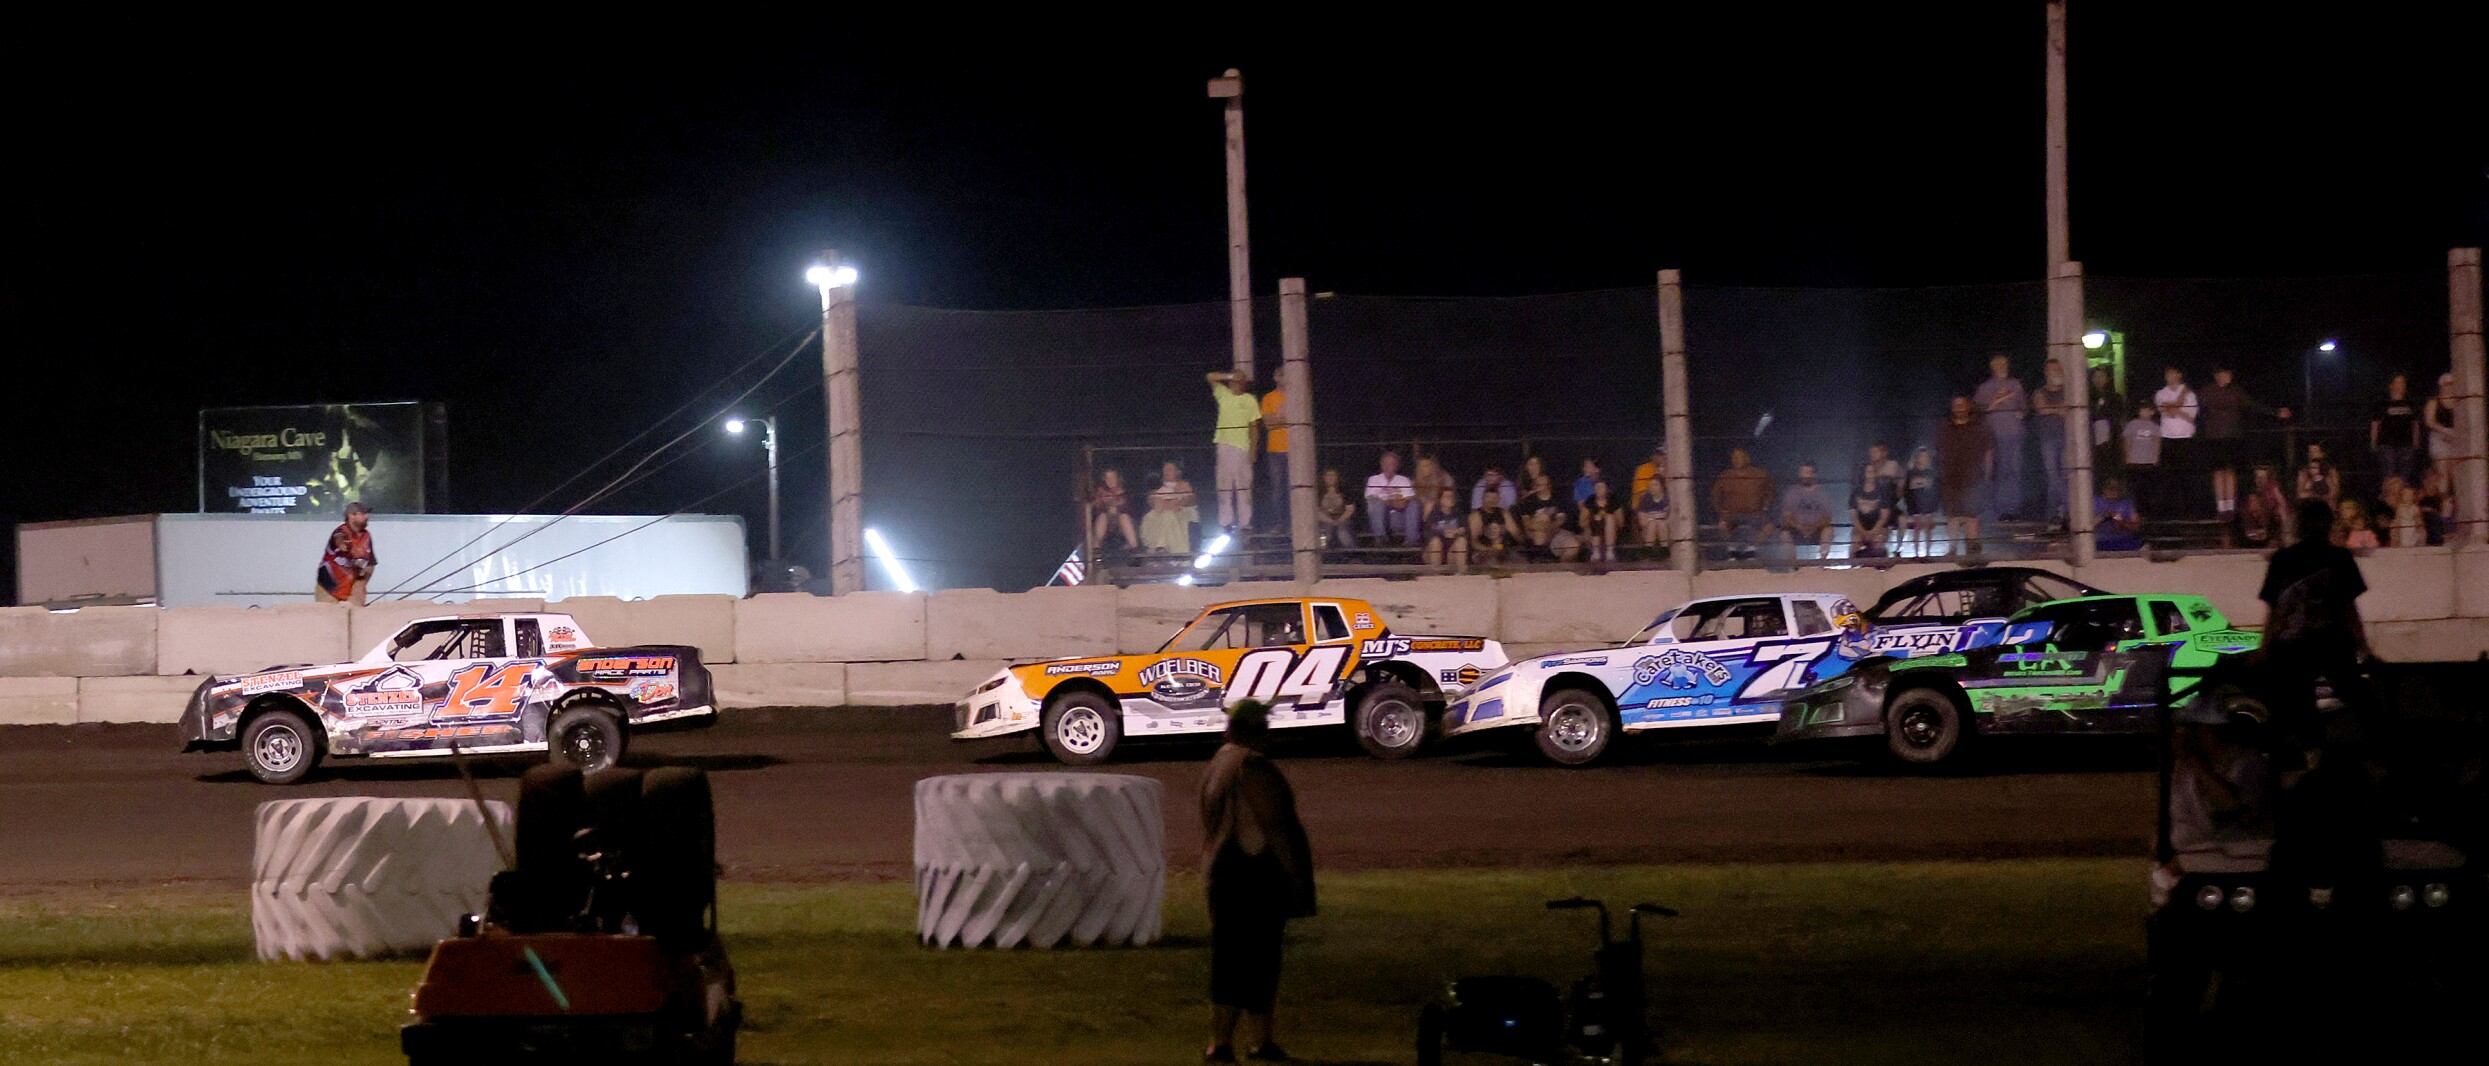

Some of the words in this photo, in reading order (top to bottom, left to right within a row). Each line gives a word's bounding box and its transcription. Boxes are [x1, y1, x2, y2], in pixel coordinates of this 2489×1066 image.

[210, 430, 278, 455] Niagara
[281, 427, 326, 447] Cave
[1361, 638, 1410, 659] MJ'S
[1464, 639, 1484, 650] LLC
[1874, 633, 1956, 649] FLYIN
[628, 668, 668, 676] PARTS
[1046, 661, 1120, 675] ANDERSON
[1139, 658, 1222, 687] WOELBER
[242, 671, 301, 687] STENZEL
[243, 679, 302, 692] EXCAVATING
[1223, 646, 1349, 709] 04
[346, 690, 419, 706] STENZEL
[433, 661, 541, 719] 14
[348, 703, 421, 713] EXCAVATING
[1647, 697, 1692, 708] FITNESS
